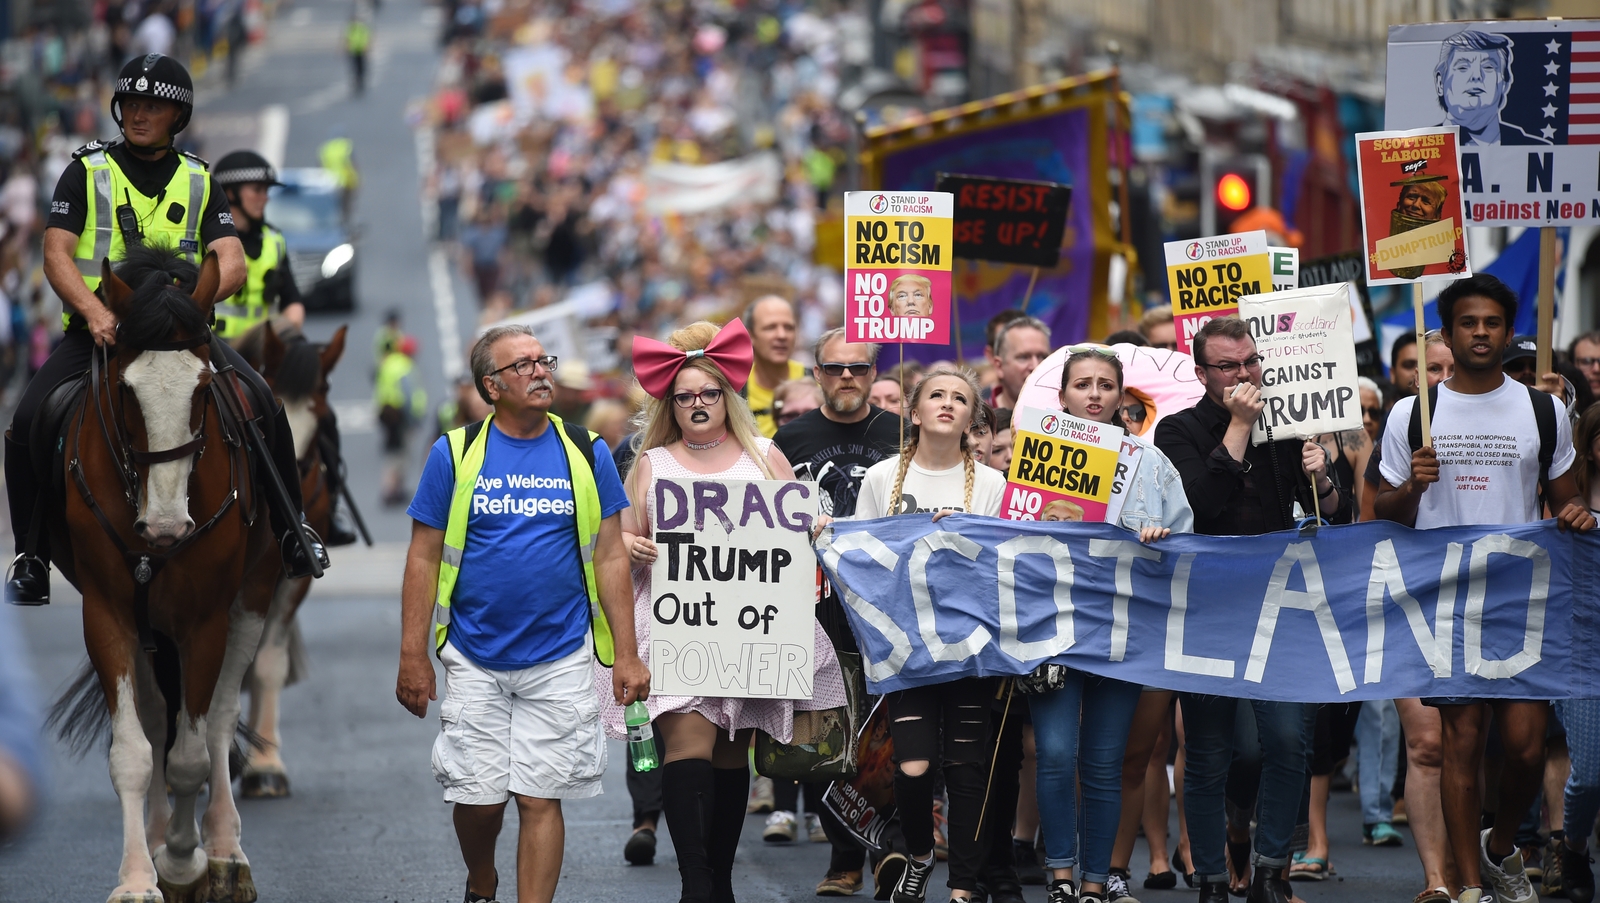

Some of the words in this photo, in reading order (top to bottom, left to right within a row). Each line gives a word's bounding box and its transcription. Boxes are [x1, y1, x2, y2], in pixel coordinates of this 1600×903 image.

[1374, 134, 1444, 150] SCOTTISH
[1382, 148, 1440, 162] LABOUR
[1404, 160, 1427, 173] says
[890, 196, 916, 204] STAND
[918, 196, 929, 204] UP
[890, 204, 901, 212] TO
[902, 205, 932, 214] RACISM
[960, 184, 1050, 214] RESIST.
[1546, 200, 1585, 219] Neo
[856, 220, 888, 242] NO
[894, 221, 924, 242] TO
[998, 221, 1048, 248] UP!
[856, 243, 940, 265] RACISM
[1206, 239, 1230, 250] STAND
[1231, 238, 1242, 246] UP
[1206, 250, 1216, 258] TO
[1218, 246, 1247, 256] RACISM
[1370, 227, 1462, 264] #DUMPTRUMP
[856, 273, 888, 294] NO
[1176, 267, 1208, 289] NO
[1212, 262, 1242, 284] TO
[854, 295, 884, 317] TO
[1179, 280, 1262, 310] RACISM
[854, 318, 934, 340] TRUMP
[1294, 315, 1338, 330] scotland
[1259, 342, 1324, 358] STUDENTS
[1260, 362, 1336, 387] GAINST
[1060, 428, 1070, 436] TO
[1070, 430, 1100, 444] RACISM
[1062, 420, 1086, 432] STAND
[1087, 425, 1098, 433] UP
[1022, 436, 1053, 462] NO
[1060, 445, 1088, 470] TO
[474, 475, 502, 492] Aye
[1017, 458, 1100, 496] RACISM
[474, 494, 574, 517] Refugees
[655, 479, 813, 535] DRAG
[1010, 488, 1042, 514] NO
[656, 532, 792, 583] TRUMP
[654, 592, 718, 626] Out
[738, 604, 778, 634] of
[825, 530, 1551, 694] SCOTLAND
[653, 640, 813, 697] POWER
